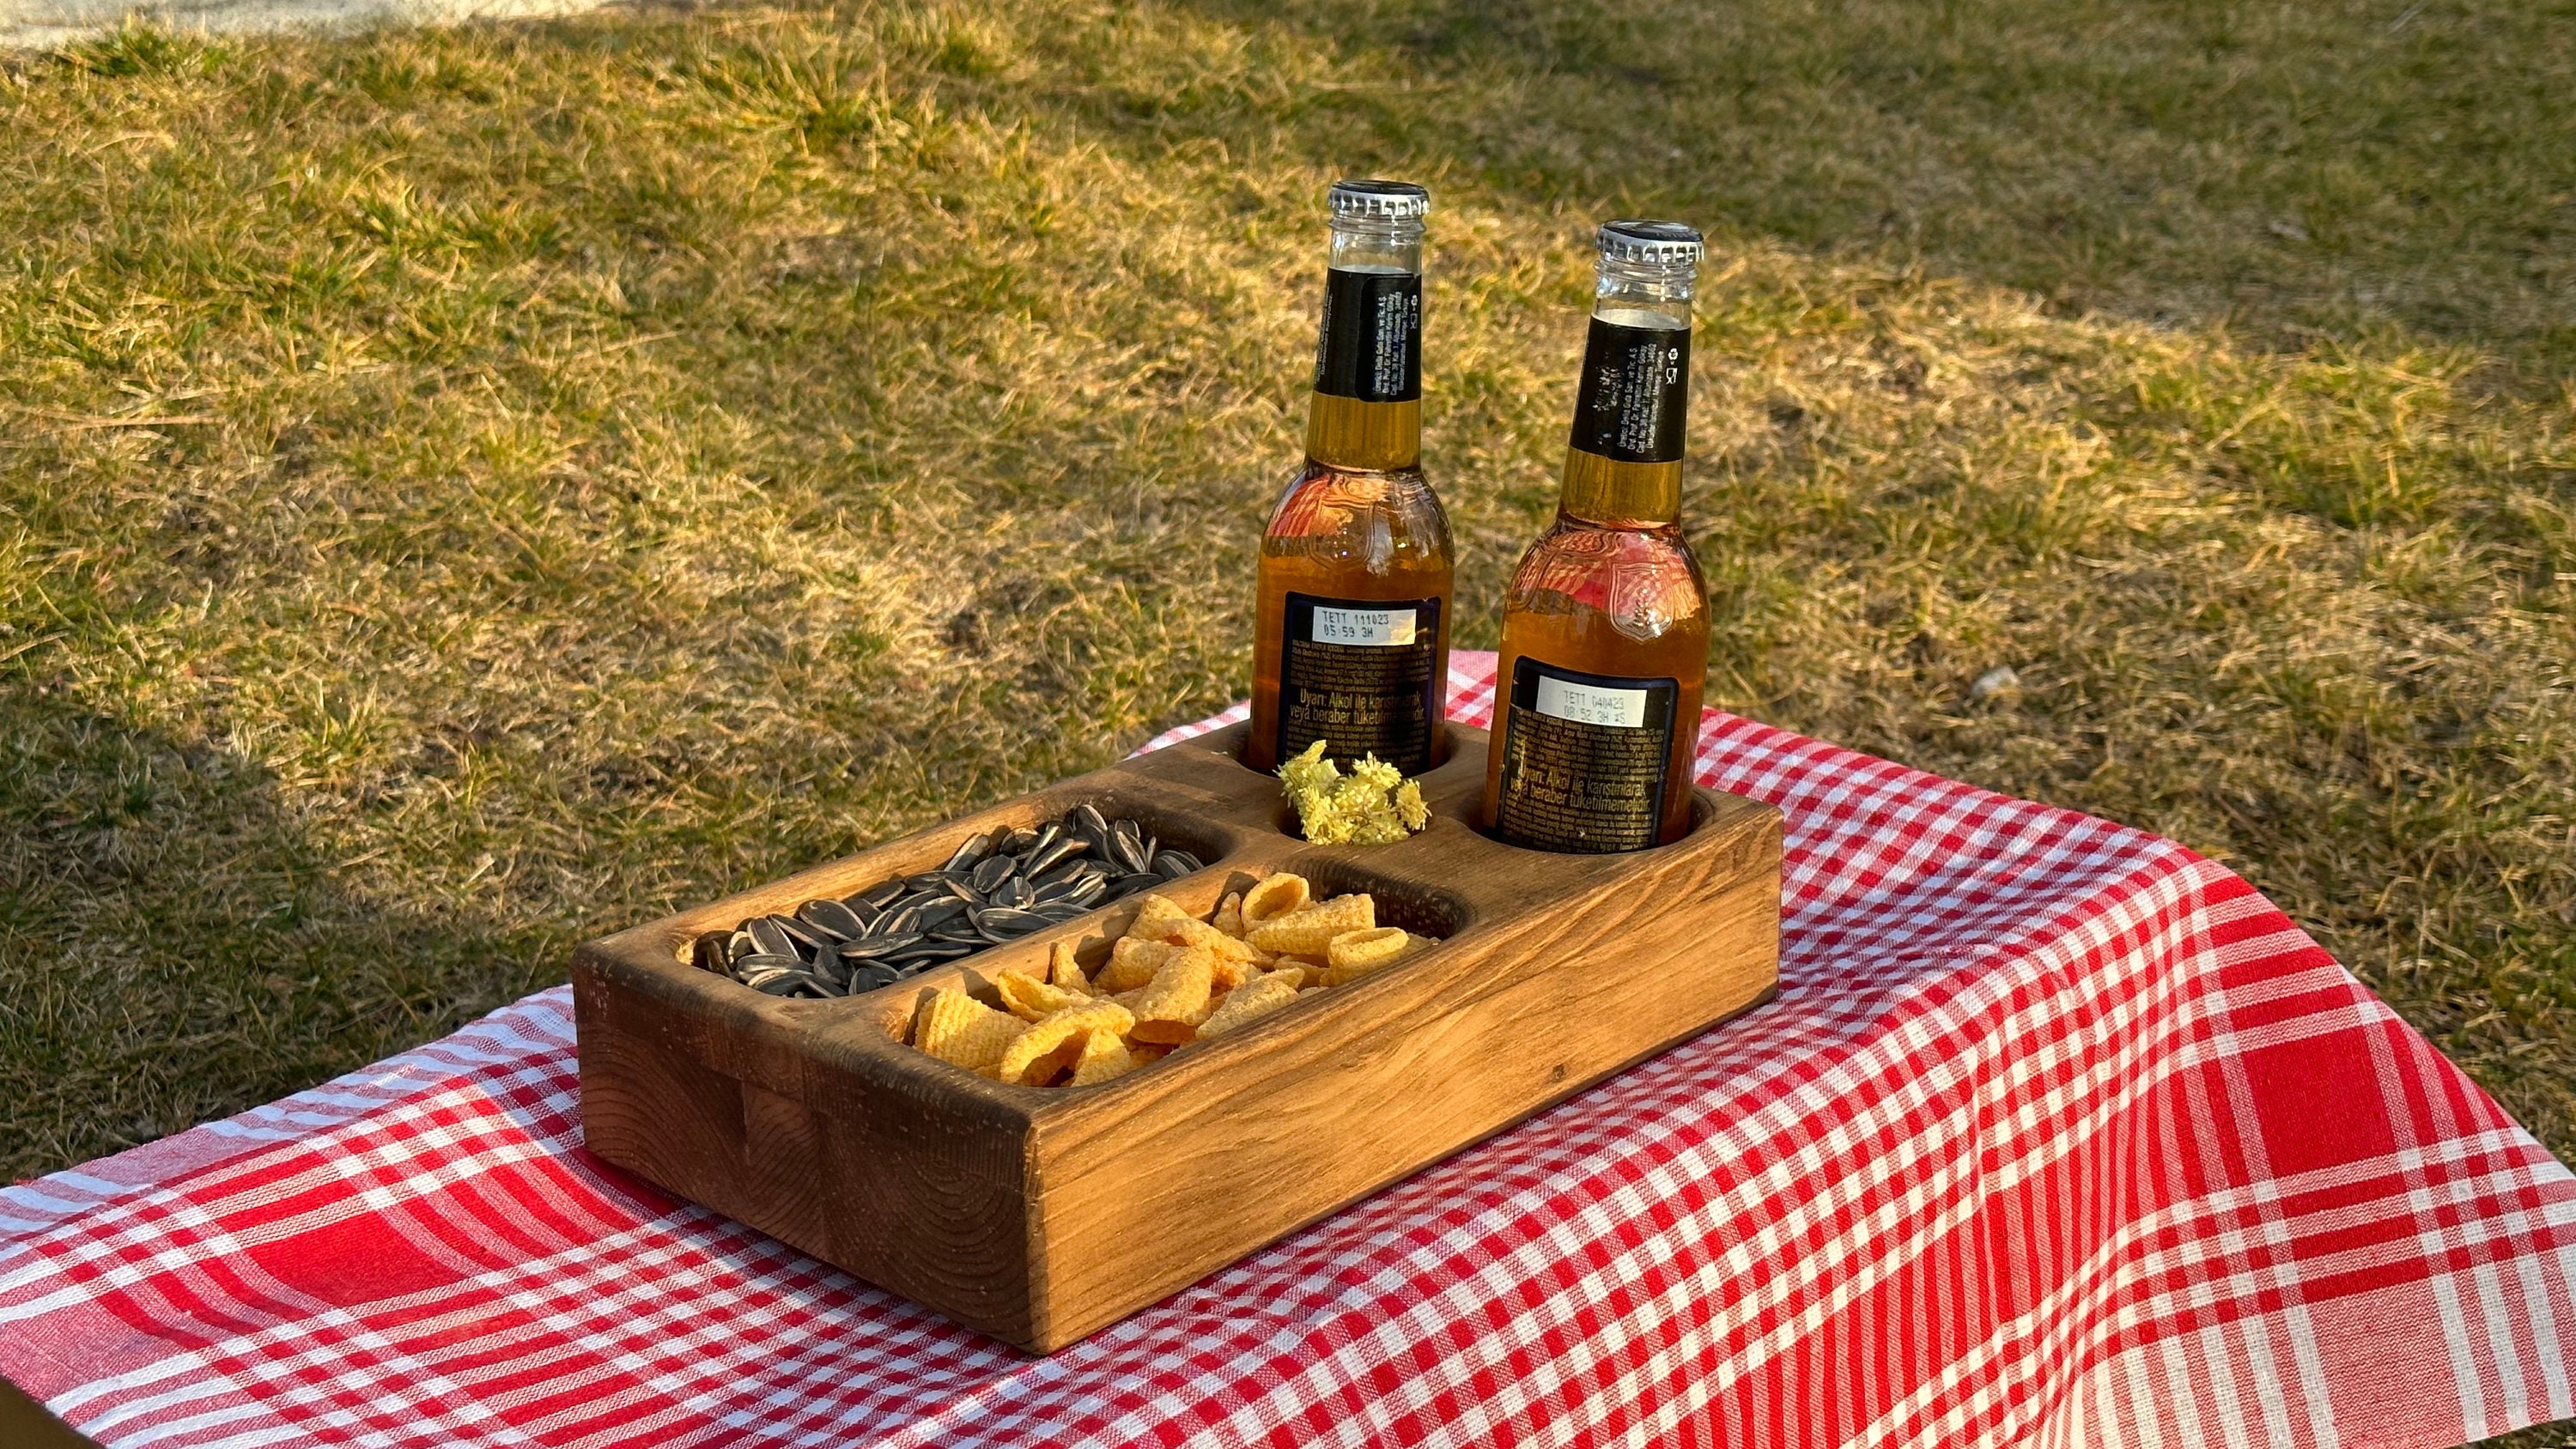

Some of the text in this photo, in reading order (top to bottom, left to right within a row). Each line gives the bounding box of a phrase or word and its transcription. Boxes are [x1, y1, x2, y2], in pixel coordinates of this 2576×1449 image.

[1321, 610, 1390, 625] TETT 111023
[1361, 627, 1374, 638] 3H
[1300, 688, 1327, 710] Uyarı:
[1328, 692, 1353, 709] Alkol
[1355, 693, 1367, 712] ile
[1562, 689, 1587, 706] TETT
[1290, 704, 1309, 721] veya
[1313, 706, 1351, 724] beraber
[1597, 710, 1608, 721] 3H
[1546, 771, 1571, 790] Alkol
[1572, 776, 1584, 793] ile
[1587, 777, 1647, 798] karıştırılarak
[1530, 782, 1568, 804] beraber
[1570, 792, 1651, 814] tüketilmemelidir.
